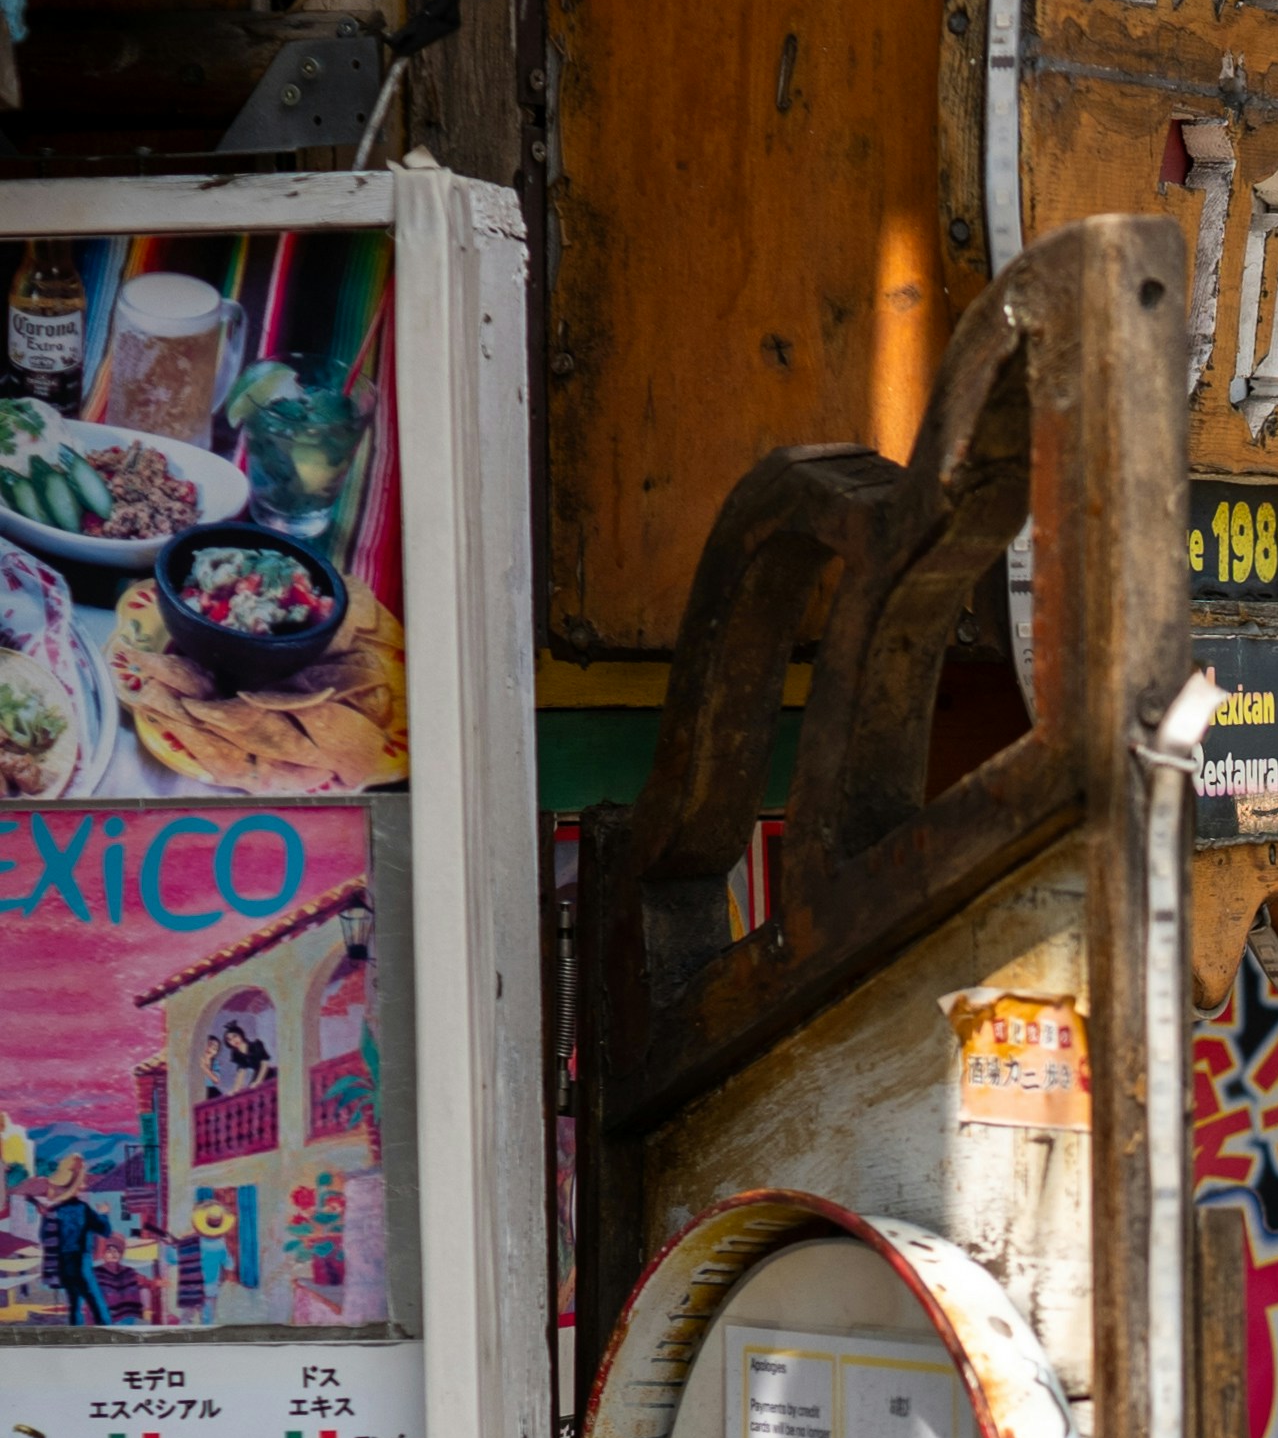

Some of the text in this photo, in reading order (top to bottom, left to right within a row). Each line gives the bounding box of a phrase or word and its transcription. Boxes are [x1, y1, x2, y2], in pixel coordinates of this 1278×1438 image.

[13, 314, 77, 338] Corona
[122, 1369, 186, 1391] モデロ
[302, 1367, 340, 1388] ドス
[89, 1399, 221, 1420] エスペシアル
[289, 1396, 355, 1417] エキス
